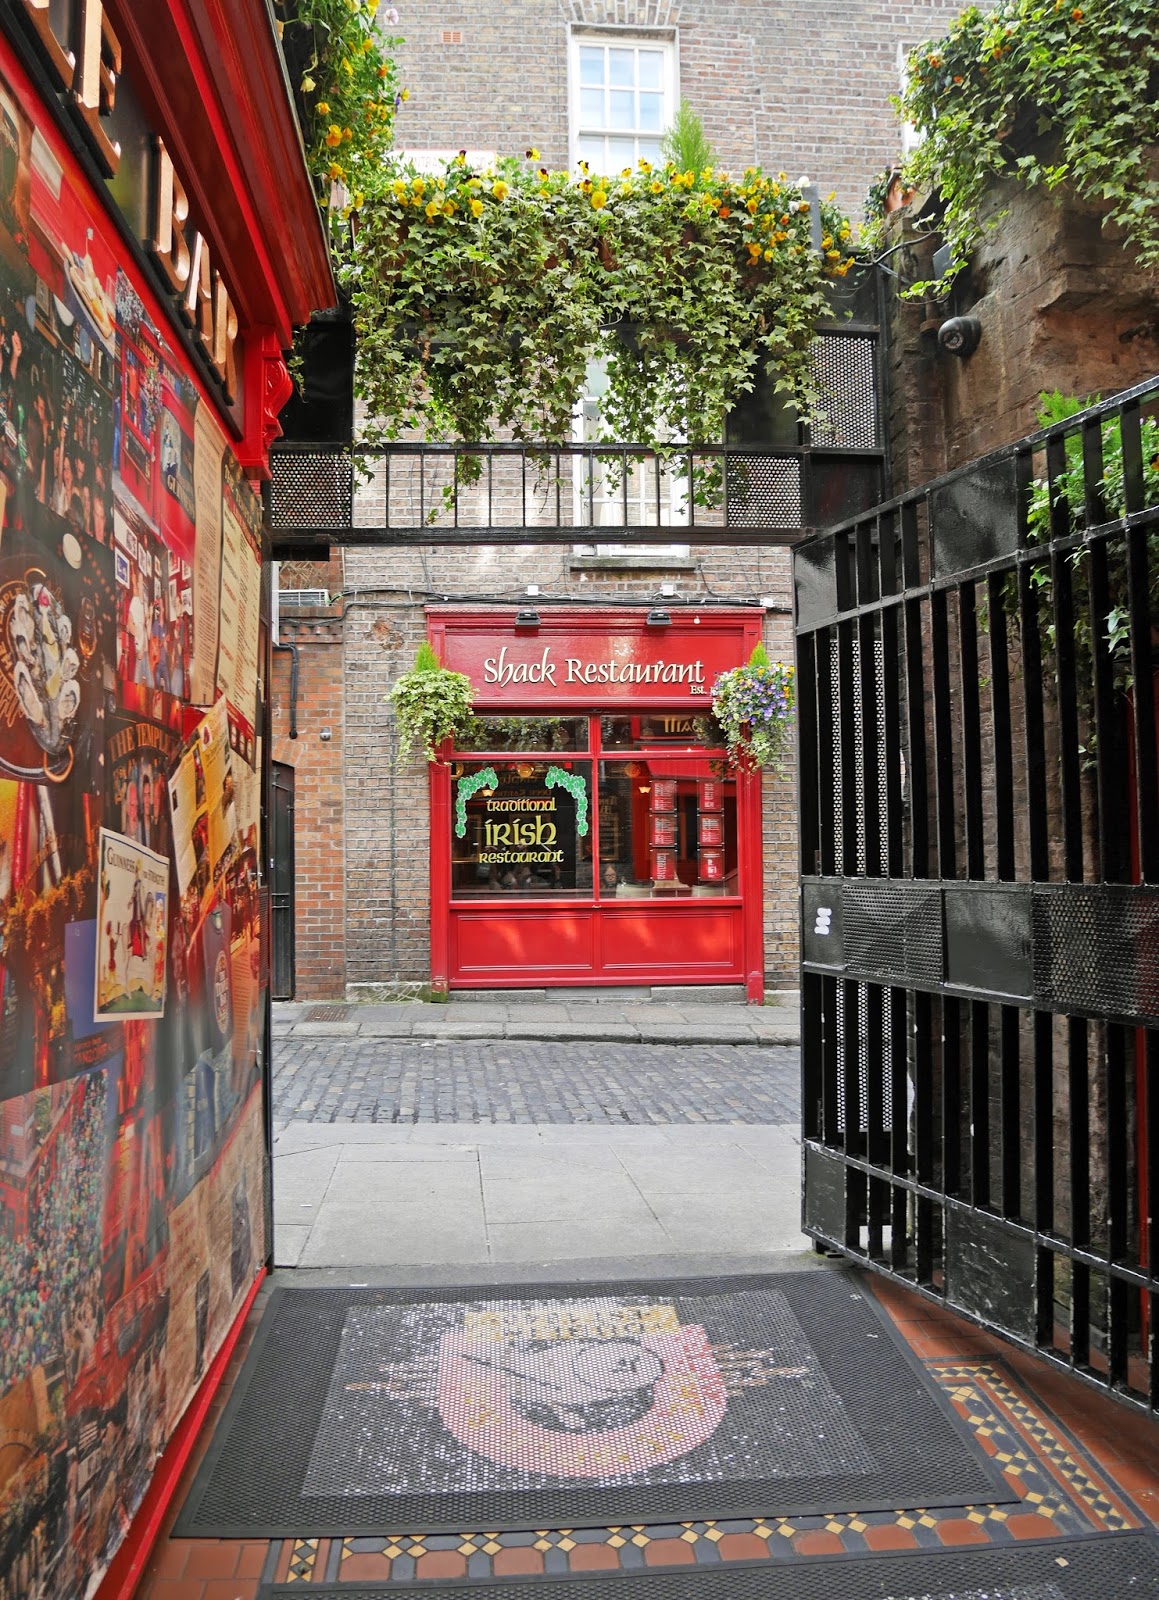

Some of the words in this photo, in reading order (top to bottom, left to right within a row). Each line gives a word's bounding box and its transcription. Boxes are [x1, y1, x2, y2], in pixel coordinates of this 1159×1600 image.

[152, 135, 238, 406] BAR
[484, 646, 557, 687] Shack
[564, 658, 705, 685] Restaurant
[690, 685, 707, 695] Est.
